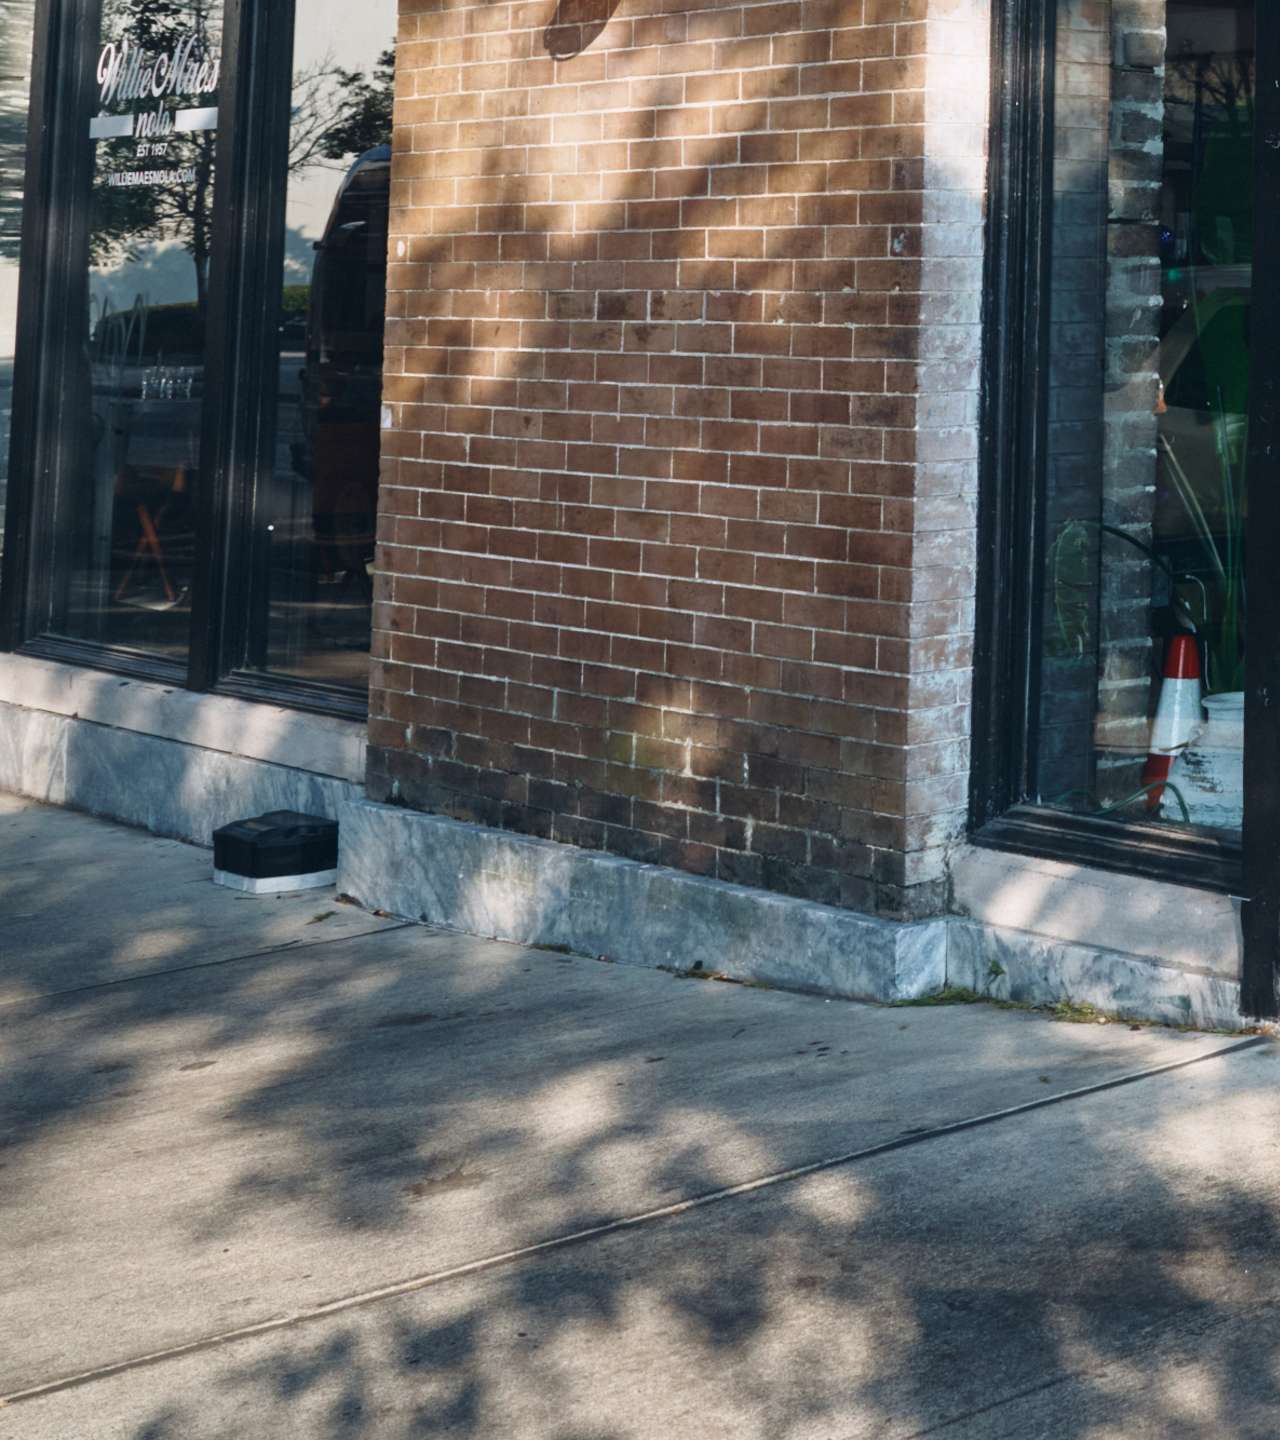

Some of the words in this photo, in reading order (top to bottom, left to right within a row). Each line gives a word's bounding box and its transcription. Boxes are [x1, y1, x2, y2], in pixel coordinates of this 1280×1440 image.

[97, 39, 152, 105] Willie
[135, 100, 174, 138] nola
[136, 144, 150, 157] EST
[151, 142, 168, 156] 1957
